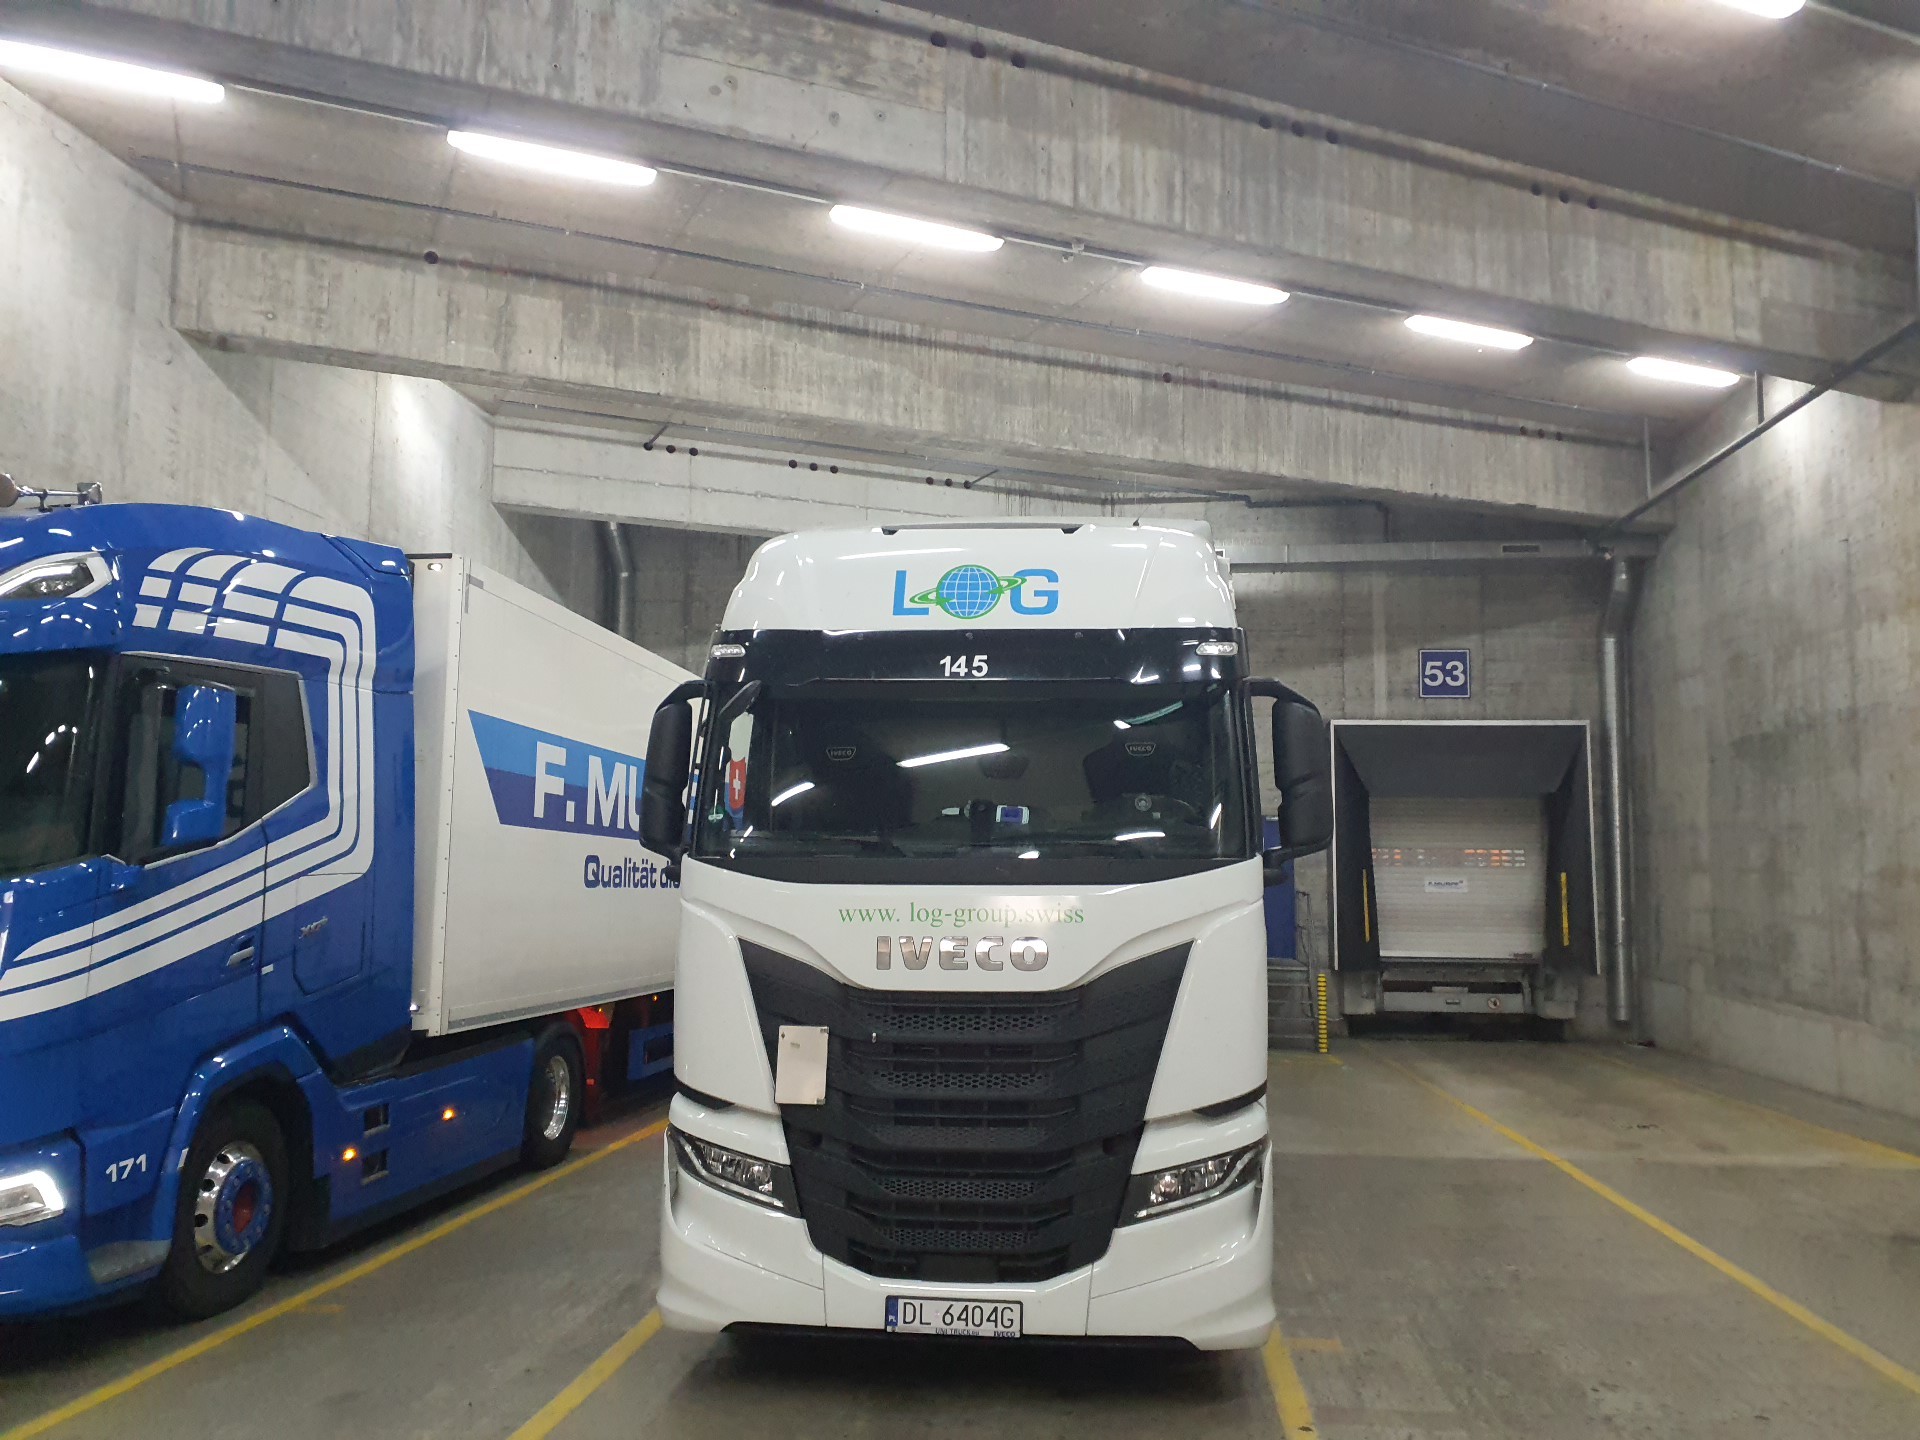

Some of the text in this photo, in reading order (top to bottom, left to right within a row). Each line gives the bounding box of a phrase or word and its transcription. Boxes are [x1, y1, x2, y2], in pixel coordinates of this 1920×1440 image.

[939, 655, 989, 677] 145
[1423, 660, 1465, 687] 53
[583, 855, 657, 889] Qualität
[876, 935, 1049, 971] IVECO
[105, 1153, 147, 1183] 171
[903, 1302, 1014, 1329] DL 6404G
